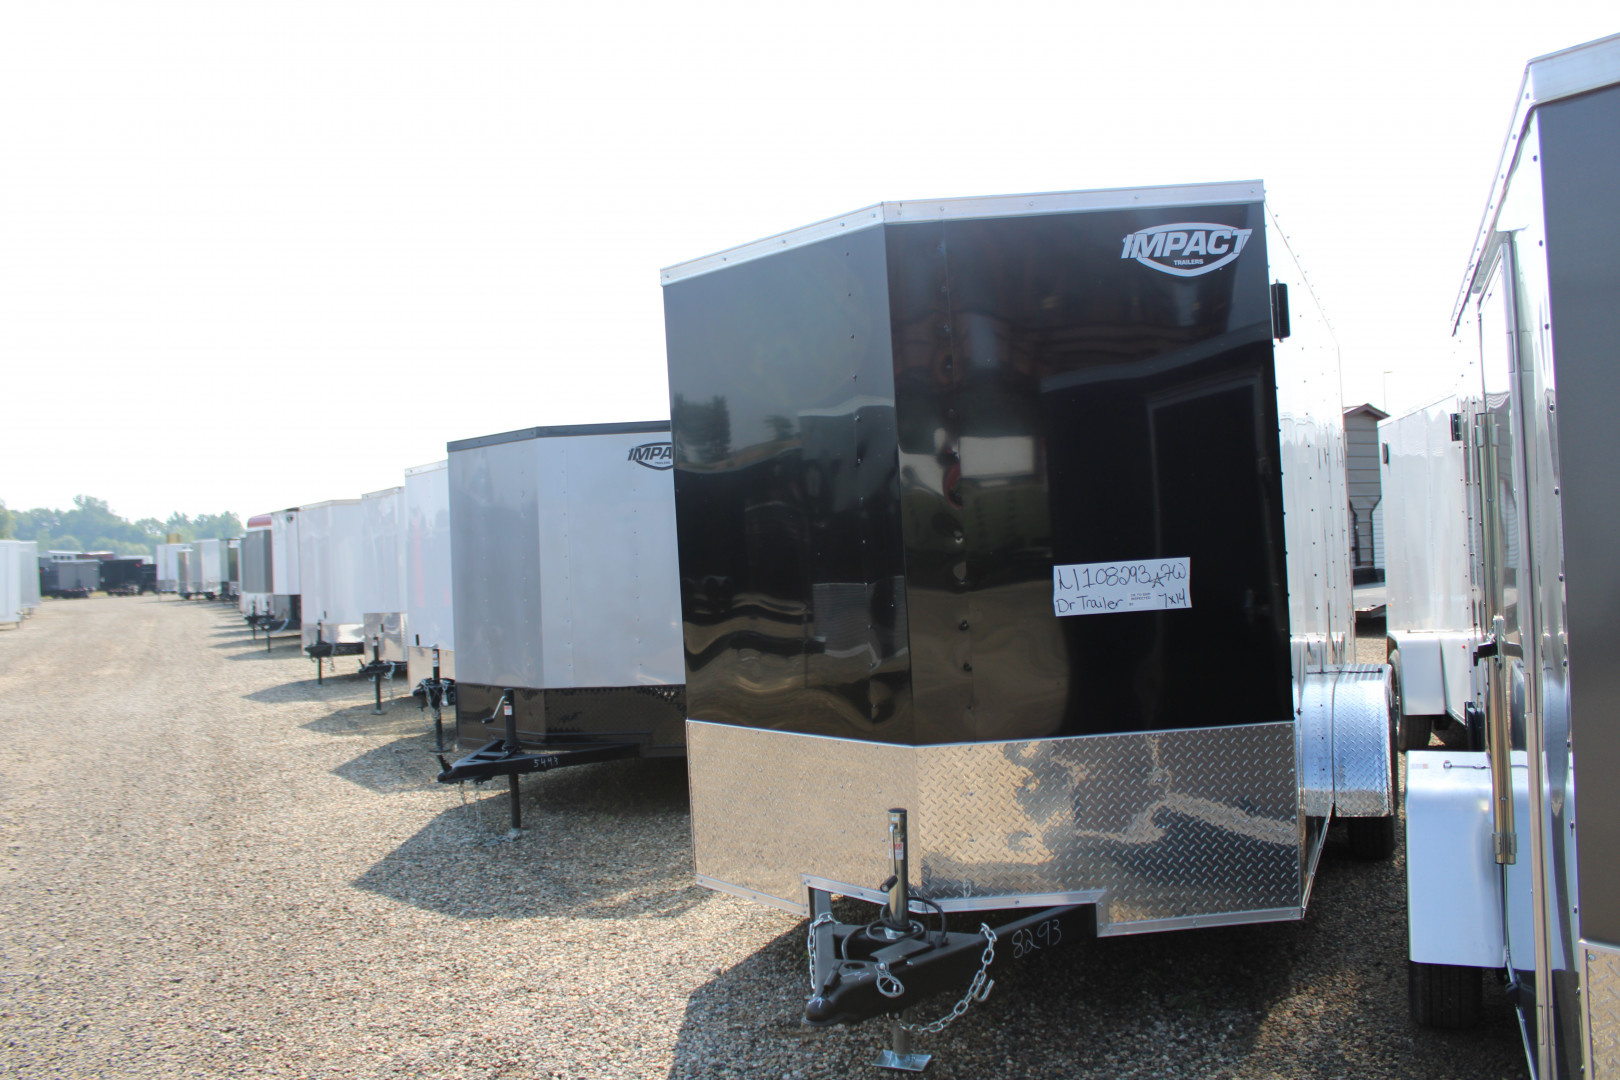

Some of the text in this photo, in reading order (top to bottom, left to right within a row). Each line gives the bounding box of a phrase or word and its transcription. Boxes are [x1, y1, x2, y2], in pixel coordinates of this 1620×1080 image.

[1121, 229, 1253, 259] IMPACT
[1055, 588, 1187, 613] Dr Trailer 7x14
[1011, 919, 1062, 959] 8293
